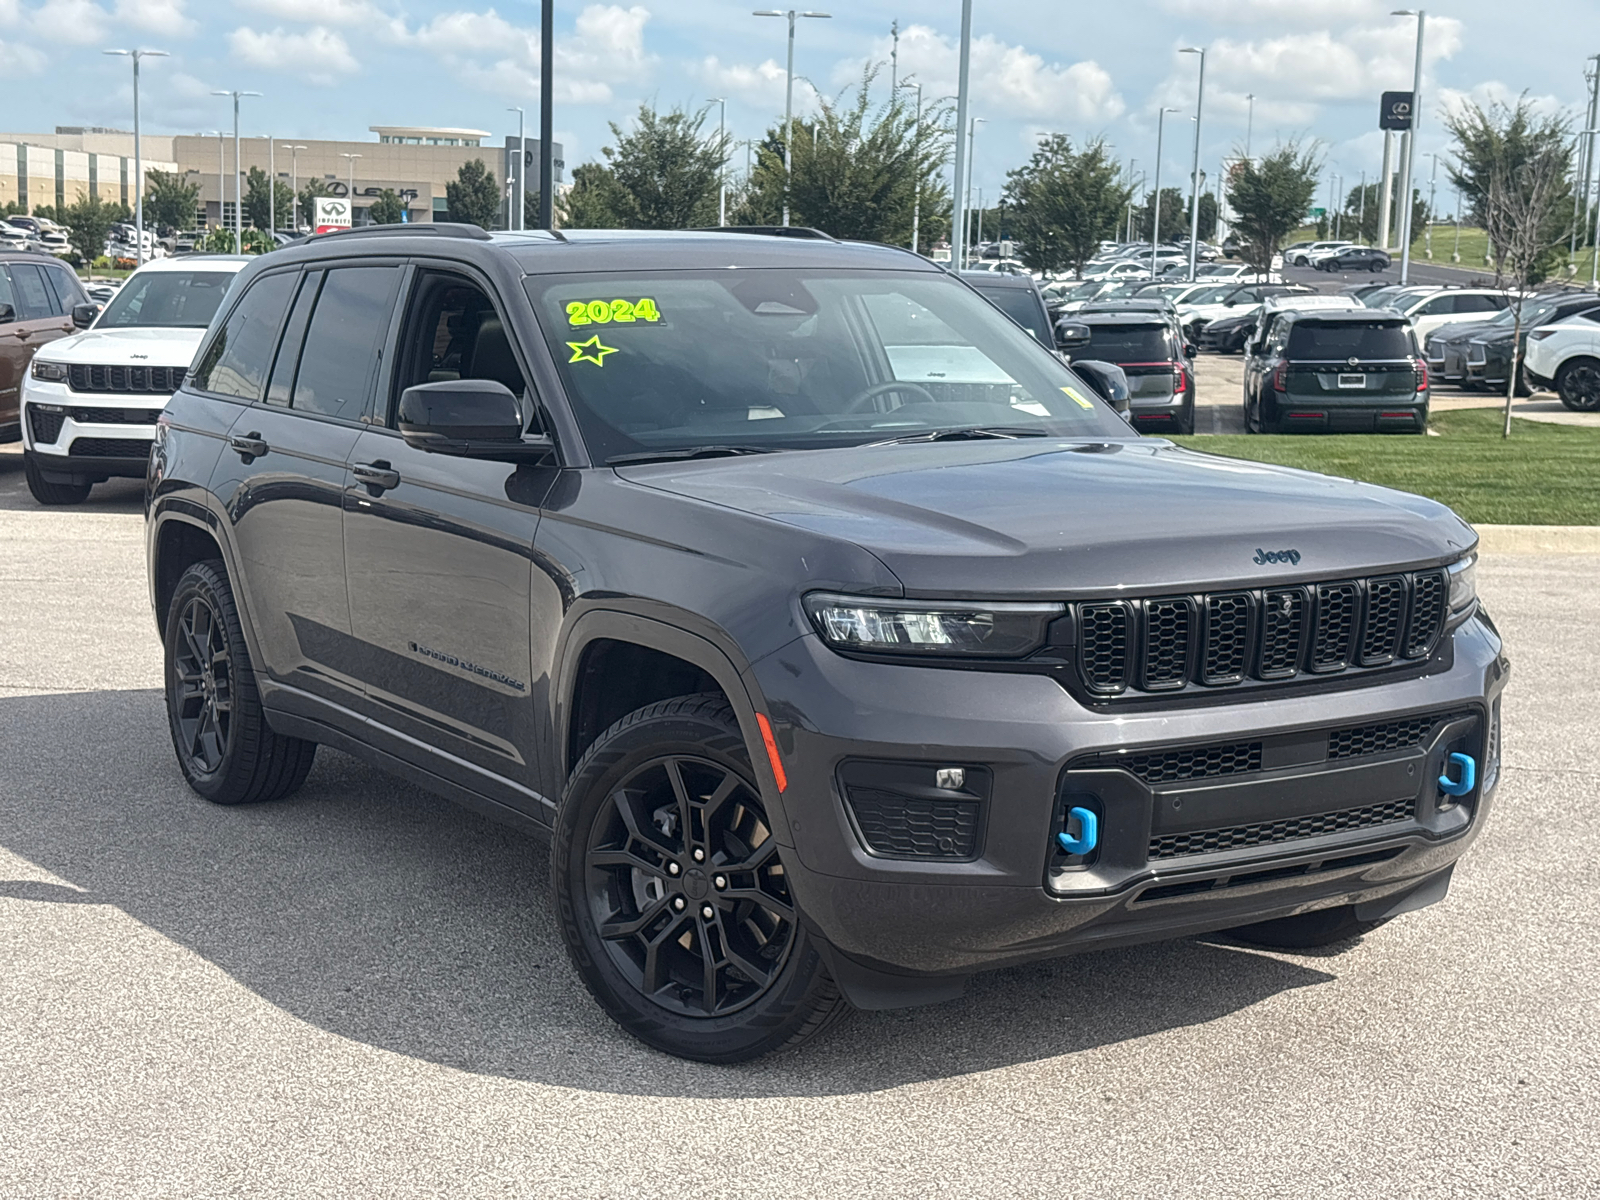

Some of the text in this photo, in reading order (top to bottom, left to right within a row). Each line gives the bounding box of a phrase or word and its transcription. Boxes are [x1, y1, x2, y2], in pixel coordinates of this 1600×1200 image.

[352, 186, 418, 199] LEUS
[565, 297, 661, 326] 2024
[1252, 547, 1302, 566] Jeep
